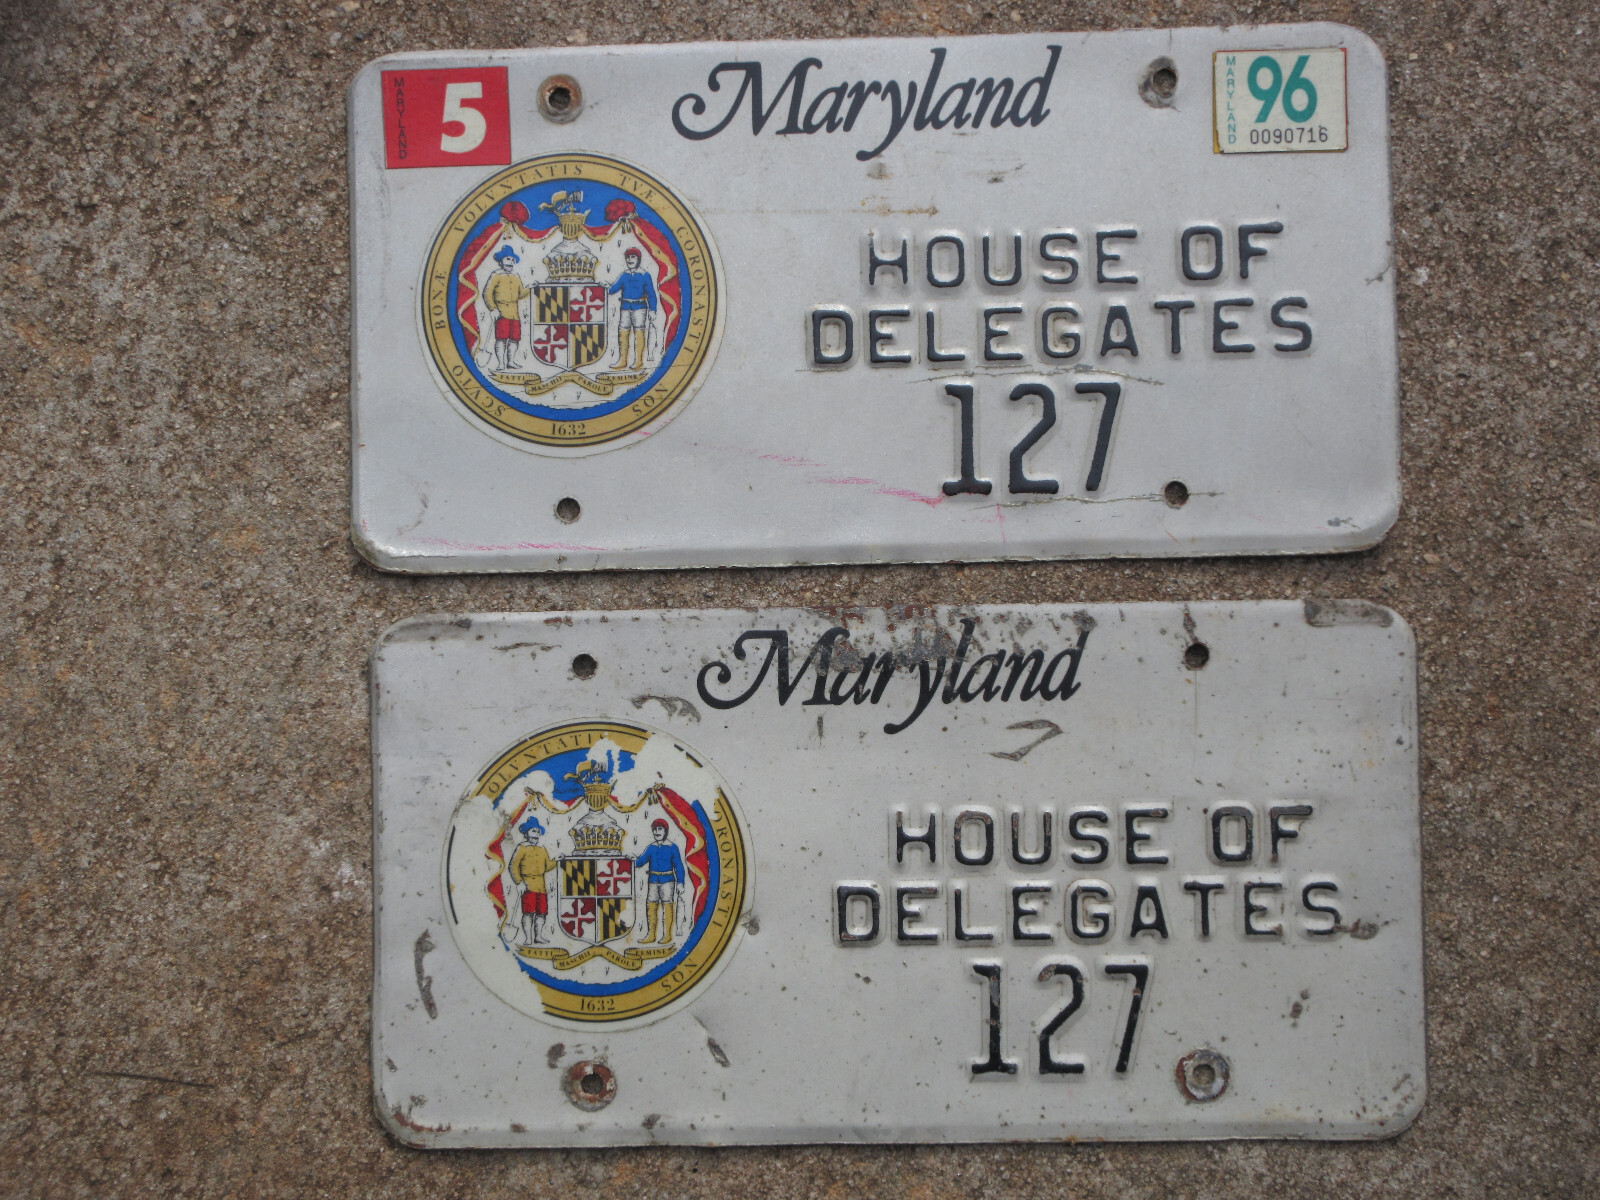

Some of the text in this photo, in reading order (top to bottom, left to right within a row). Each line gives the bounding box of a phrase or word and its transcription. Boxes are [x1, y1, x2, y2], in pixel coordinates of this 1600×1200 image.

[394, 77, 408, 160] MARYLAND
[440, 81, 487, 154] 5
[671, 45, 1063, 161] Maryland
[1226, 55, 1237, 145] MARYLAND
[1247, 54, 1319, 124] 96
[1250, 126, 1329, 145] 0090716
[867, 220, 1284, 288] HOUSE OF
[811, 296, 1314, 365] DELEGATES
[551, 422, 586, 436] 1632
[942, 381, 1122, 497] 127
[696, 614, 1093, 735] Maryland
[895, 804, 1314, 866] HOUSE OF
[836, 880, 1341, 943] DELEGATES
[579, 998, 616, 1012] 1632
[970, 962, 1149, 1075] 127
